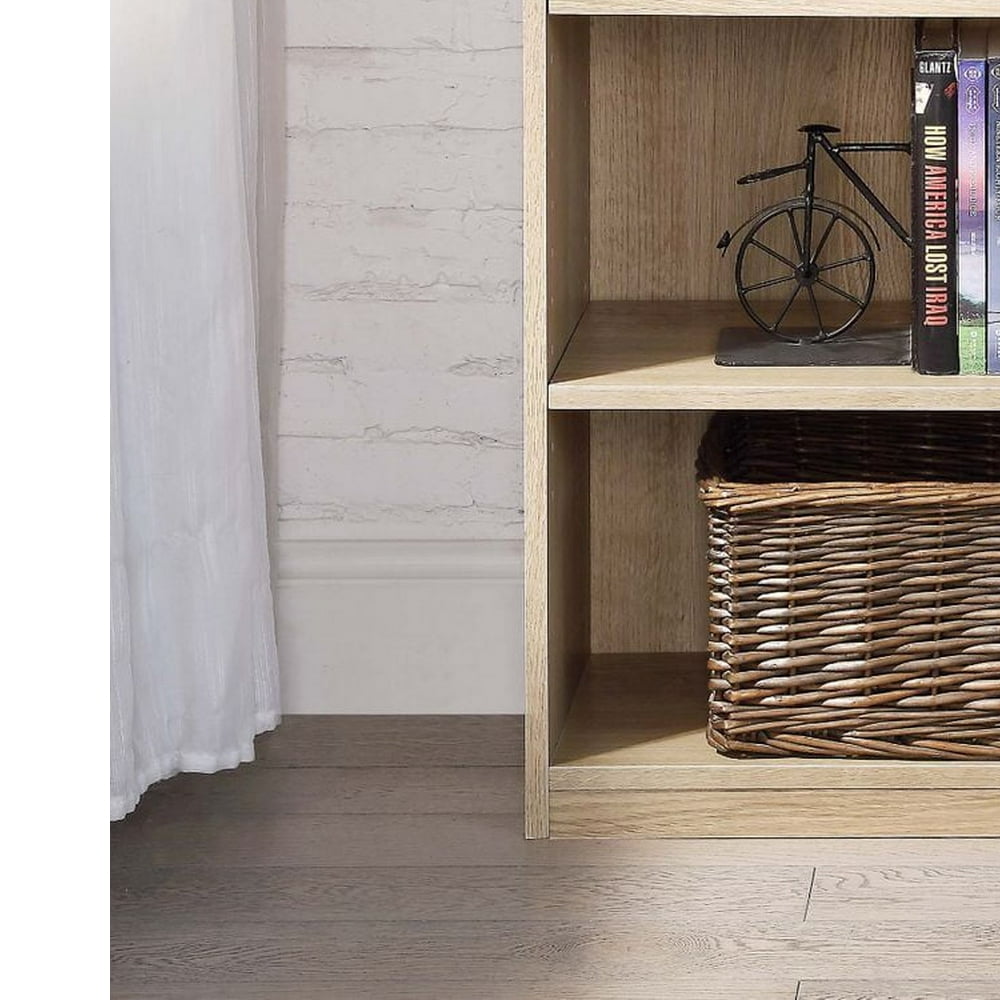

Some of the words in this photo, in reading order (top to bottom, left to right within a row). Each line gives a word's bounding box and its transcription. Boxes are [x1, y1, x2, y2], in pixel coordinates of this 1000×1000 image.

[918, 61, 951, 75] GLANTZ
[924, 126, 947, 161] HOW
[924, 165, 947, 240] AMERICA
[925, 245, 948, 283] LOST
[924, 287, 948, 327] IRAQ
